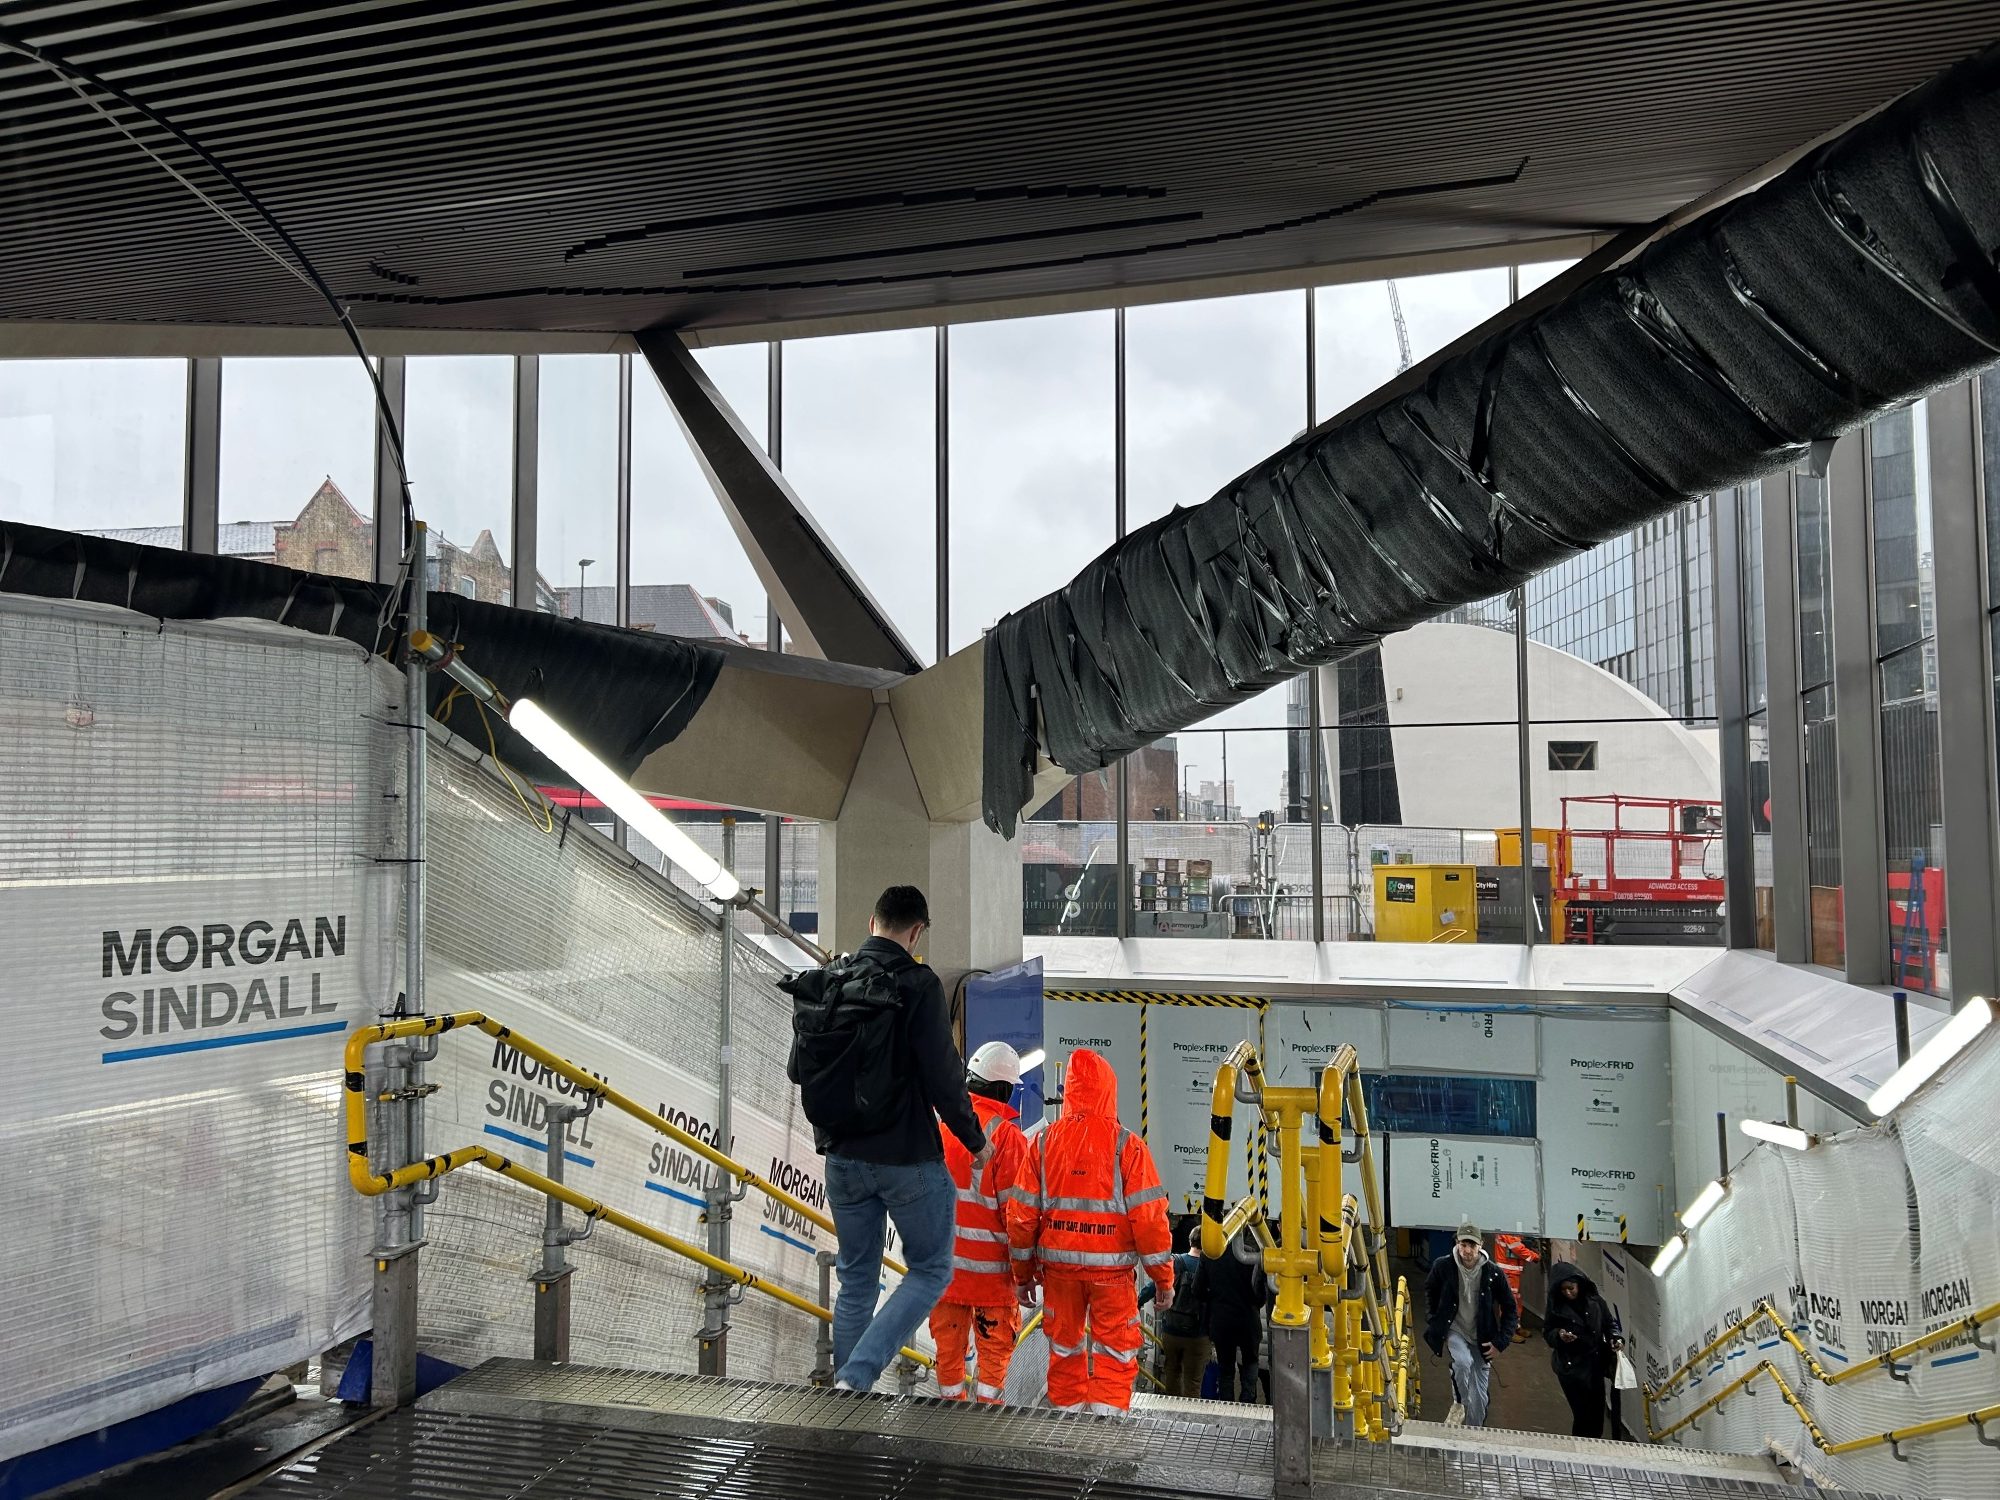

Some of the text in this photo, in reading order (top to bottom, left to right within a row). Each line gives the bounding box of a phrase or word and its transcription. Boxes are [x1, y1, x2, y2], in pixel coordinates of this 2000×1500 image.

[1648, 882, 1698, 891] ADVANCED ACCESS
[102, 915, 346, 978] MORGAN
[99, 972, 339, 1040] SINDALL
[768, 1156, 826, 1211] MORGAN
[1097, 1224, 1106, 1236] DO
[1921, 1277, 1972, 1320] MORGAN
